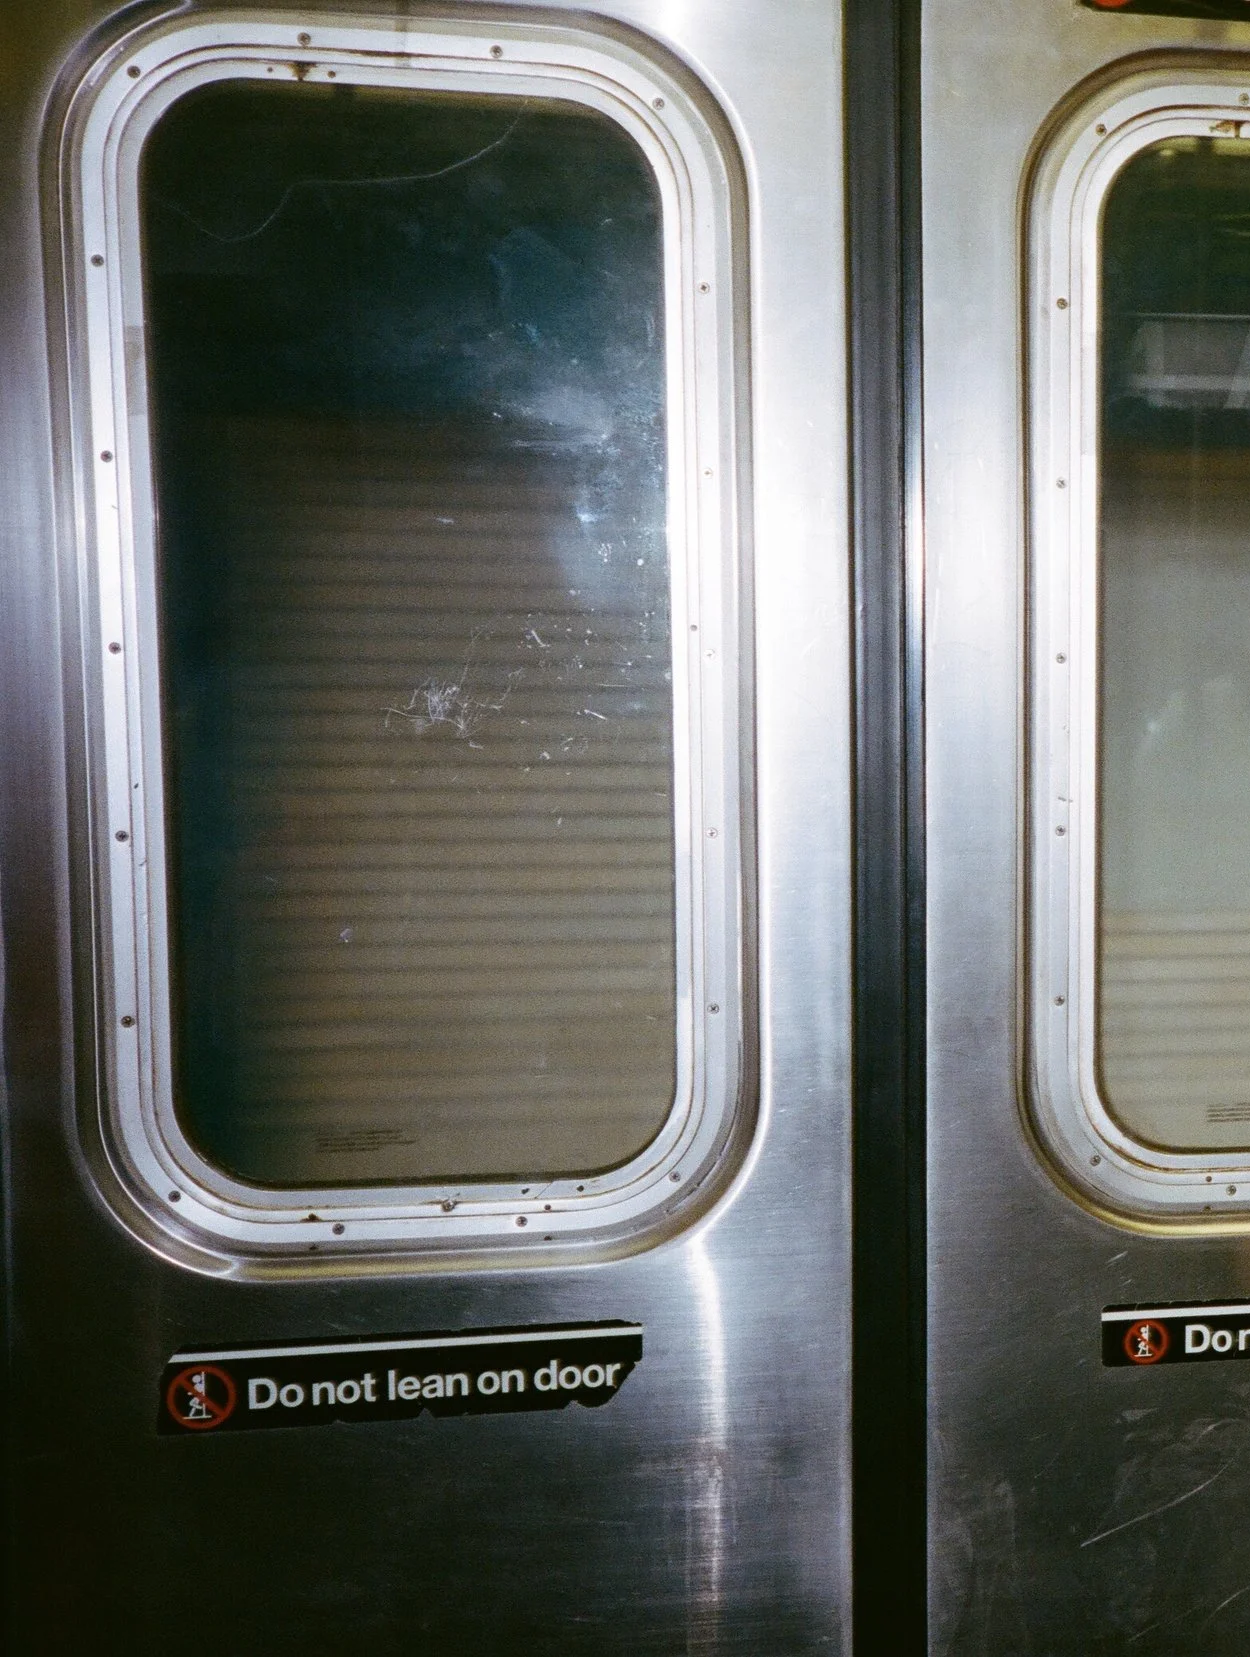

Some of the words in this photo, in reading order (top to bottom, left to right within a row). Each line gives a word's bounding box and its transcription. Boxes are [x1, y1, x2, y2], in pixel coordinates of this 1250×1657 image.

[1184, 1323, 1233, 1354] Do
[248, 1376, 305, 1410] Do
[312, 1372, 377, 1406] not
[388, 1368, 469, 1401] lean
[477, 1369, 525, 1395] on
[534, 1358, 621, 1392] door
